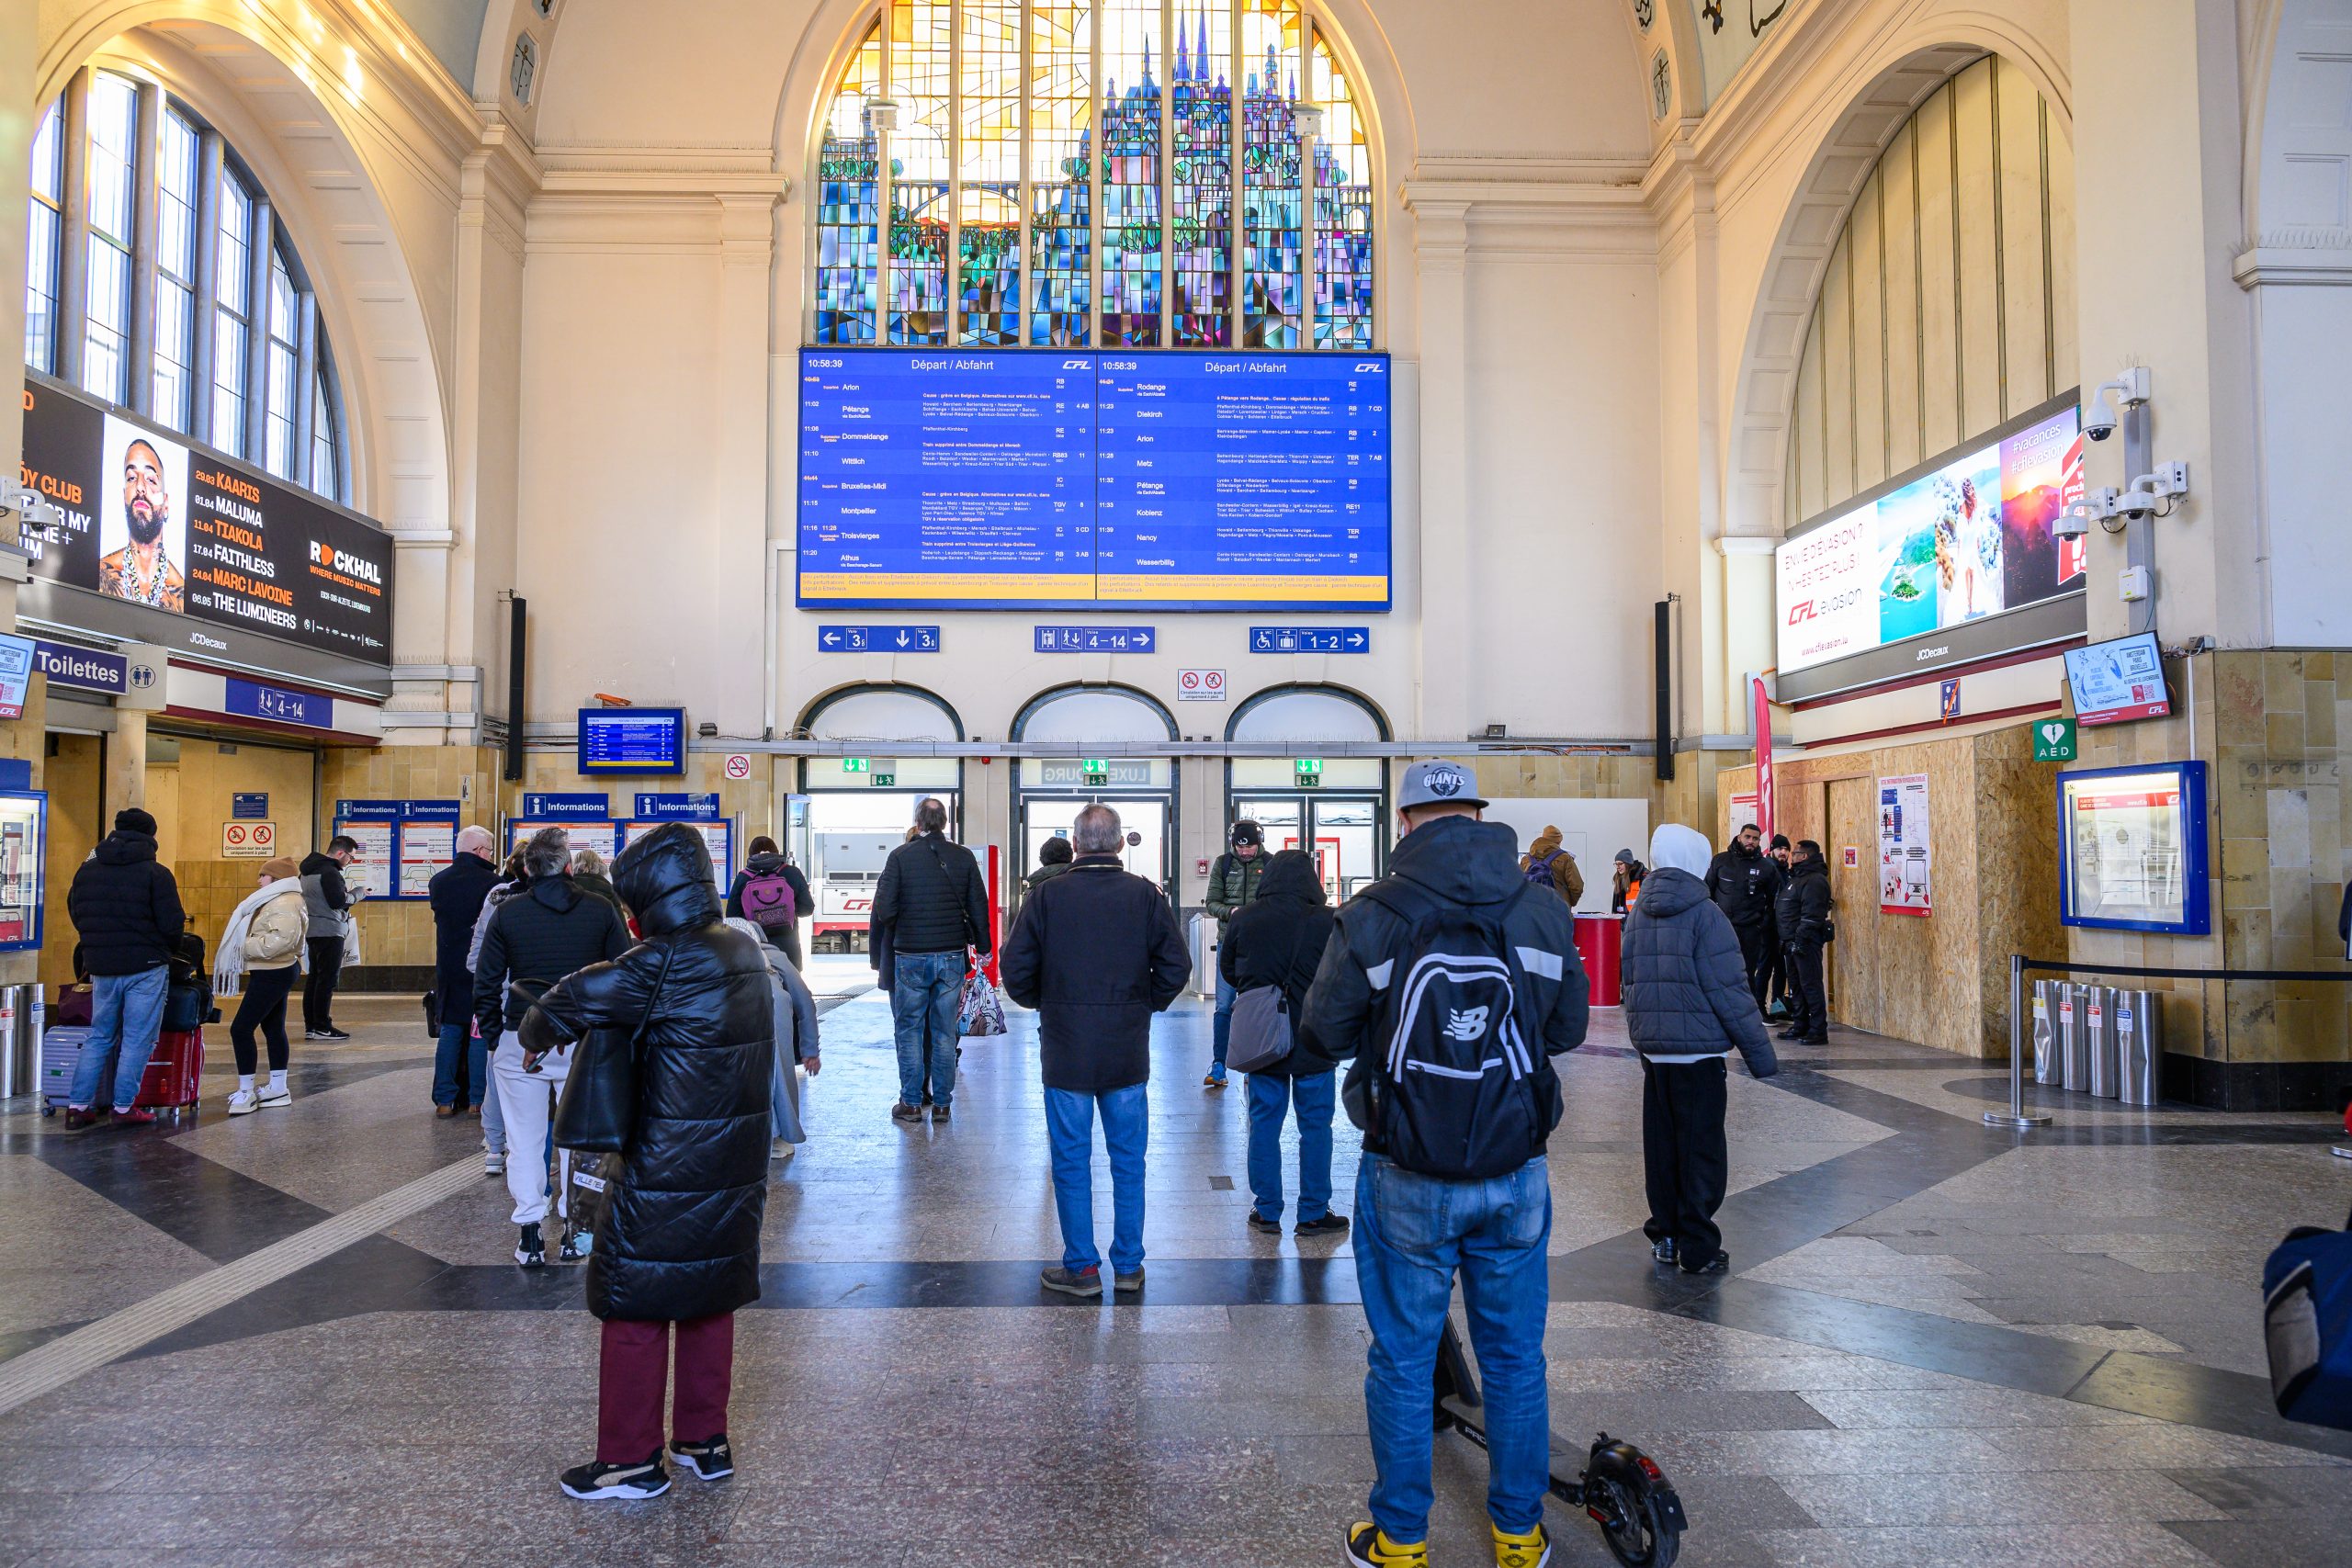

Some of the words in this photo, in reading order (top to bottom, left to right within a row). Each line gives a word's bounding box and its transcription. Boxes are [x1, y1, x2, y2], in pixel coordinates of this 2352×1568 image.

[912, 360, 946, 371] Départ
[956, 360, 993, 369] Abfahrt
[1063, 361, 1091, 369] CFL
[1205, 363, 1239, 374] Départ
[1249, 363, 1286, 372] Abfahrt
[1355, 364, 1383, 372] CFL
[2013, 422, 2061, 455] #vacances
[2011, 442, 2064, 475] #cflevasion
[40, 475, 82, 504] CLUB
[196, 470, 214, 485] 29.03
[217, 472, 260, 503] KAARIS
[195, 495, 214, 509] 01.04
[216, 496, 263, 528] MALUMA
[68, 512, 91, 534] MY
[194, 520, 213, 534] 11.04
[215, 520, 263, 551] TIAKOLA
[194, 544, 212, 558] 17.04
[214, 544, 275, 578] FAITHLESS
[193, 569, 211, 582] 24.04
[213, 568, 246, 592] MARC
[248, 579, 292, 606] LAVOINE
[310, 565, 332, 580] WHERE
[334, 573, 354, 588] MUSIC
[355, 581, 381, 596] MATTERS
[192, 593, 211, 607] 06.05
[213, 592, 234, 613] THE
[237, 599, 296, 629] LUMINEERS
[1789, 599, 1817, 626] CFL
[189, 632, 227, 650] JCDecaux
[853, 635, 860, 647] 3
[922, 635, 930, 647] 3
[1917, 644, 1949, 661] JCDecaux
[38, 650, 119, 683] Toilettes
[2149, 705, 2165, 714] CFL
[2040, 746, 2069, 757] AED
[1424, 773, 1464, 787] GIANTS
[415, 806, 458, 814] Informations
[548, 803, 605, 811] Informations
[659, 803, 716, 811] Informations
[843, 899, 873, 910] CF
